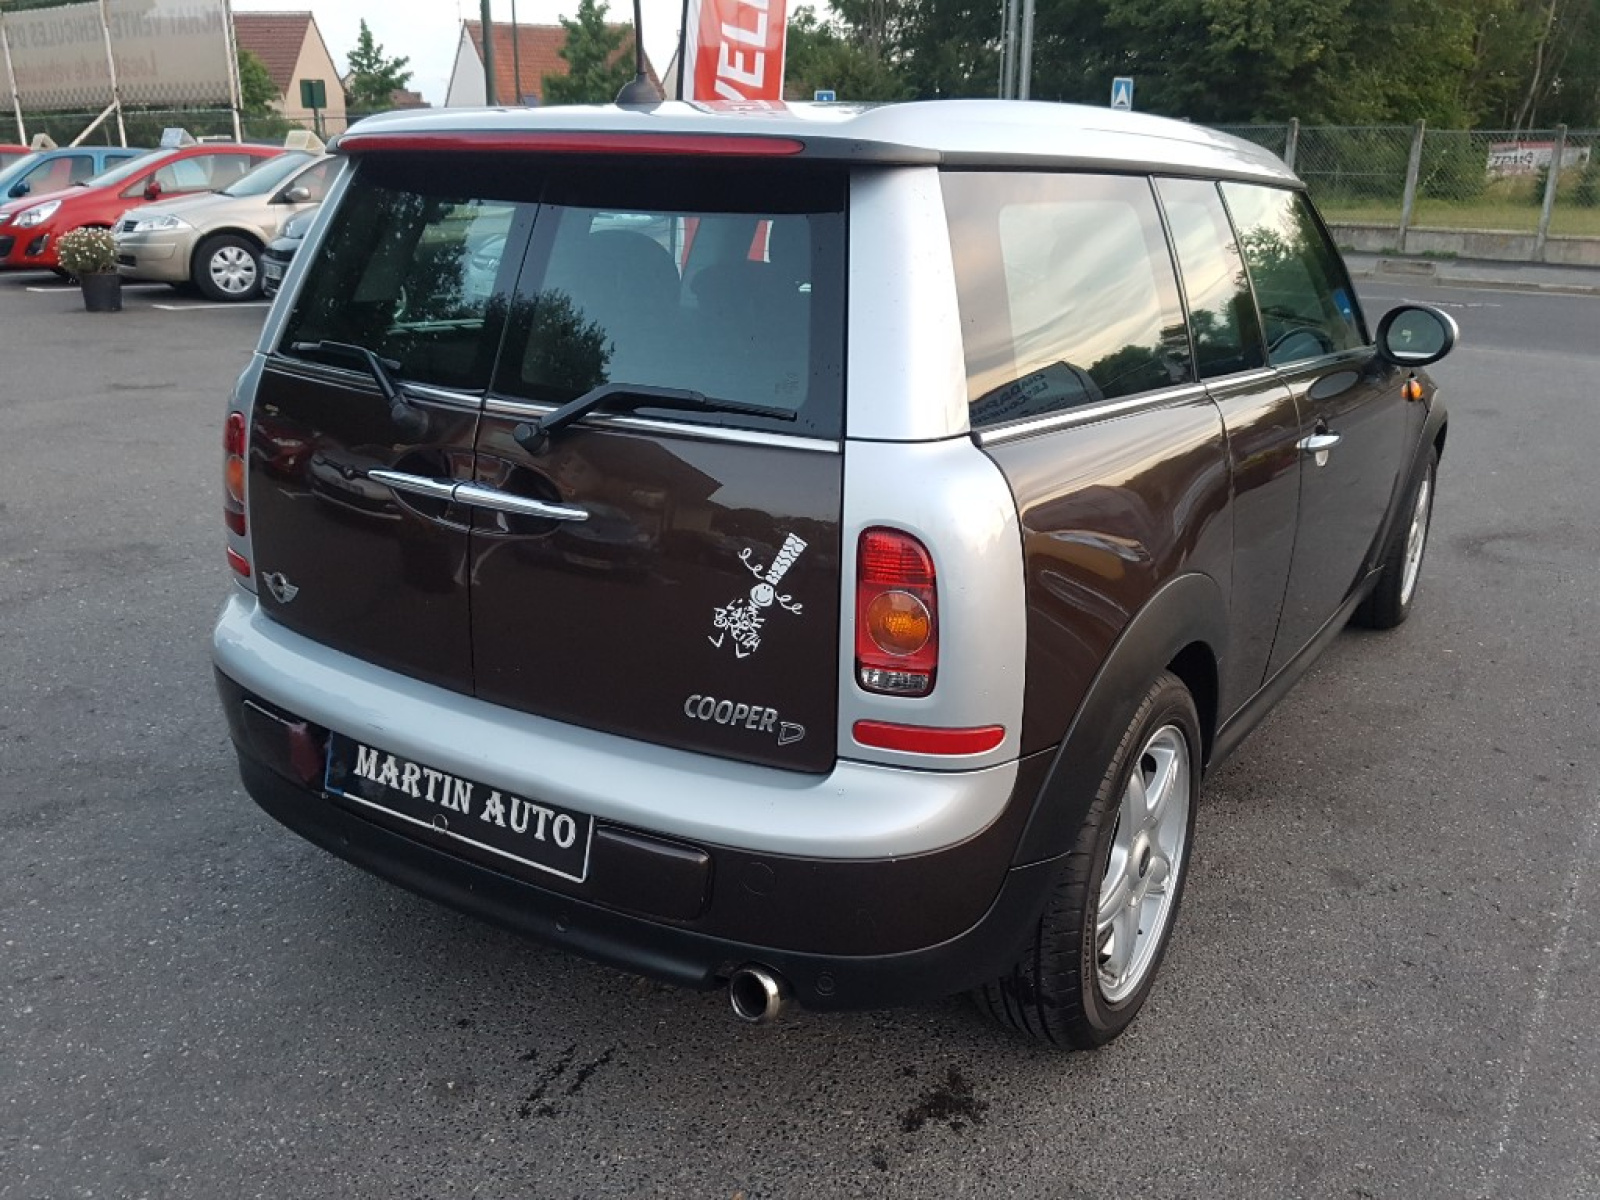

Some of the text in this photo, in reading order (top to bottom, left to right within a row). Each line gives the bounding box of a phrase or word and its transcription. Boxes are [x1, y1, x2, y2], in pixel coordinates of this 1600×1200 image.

[684, 694, 806, 746] COOPER D
[353, 744, 577, 848] MARTIN AUTO
